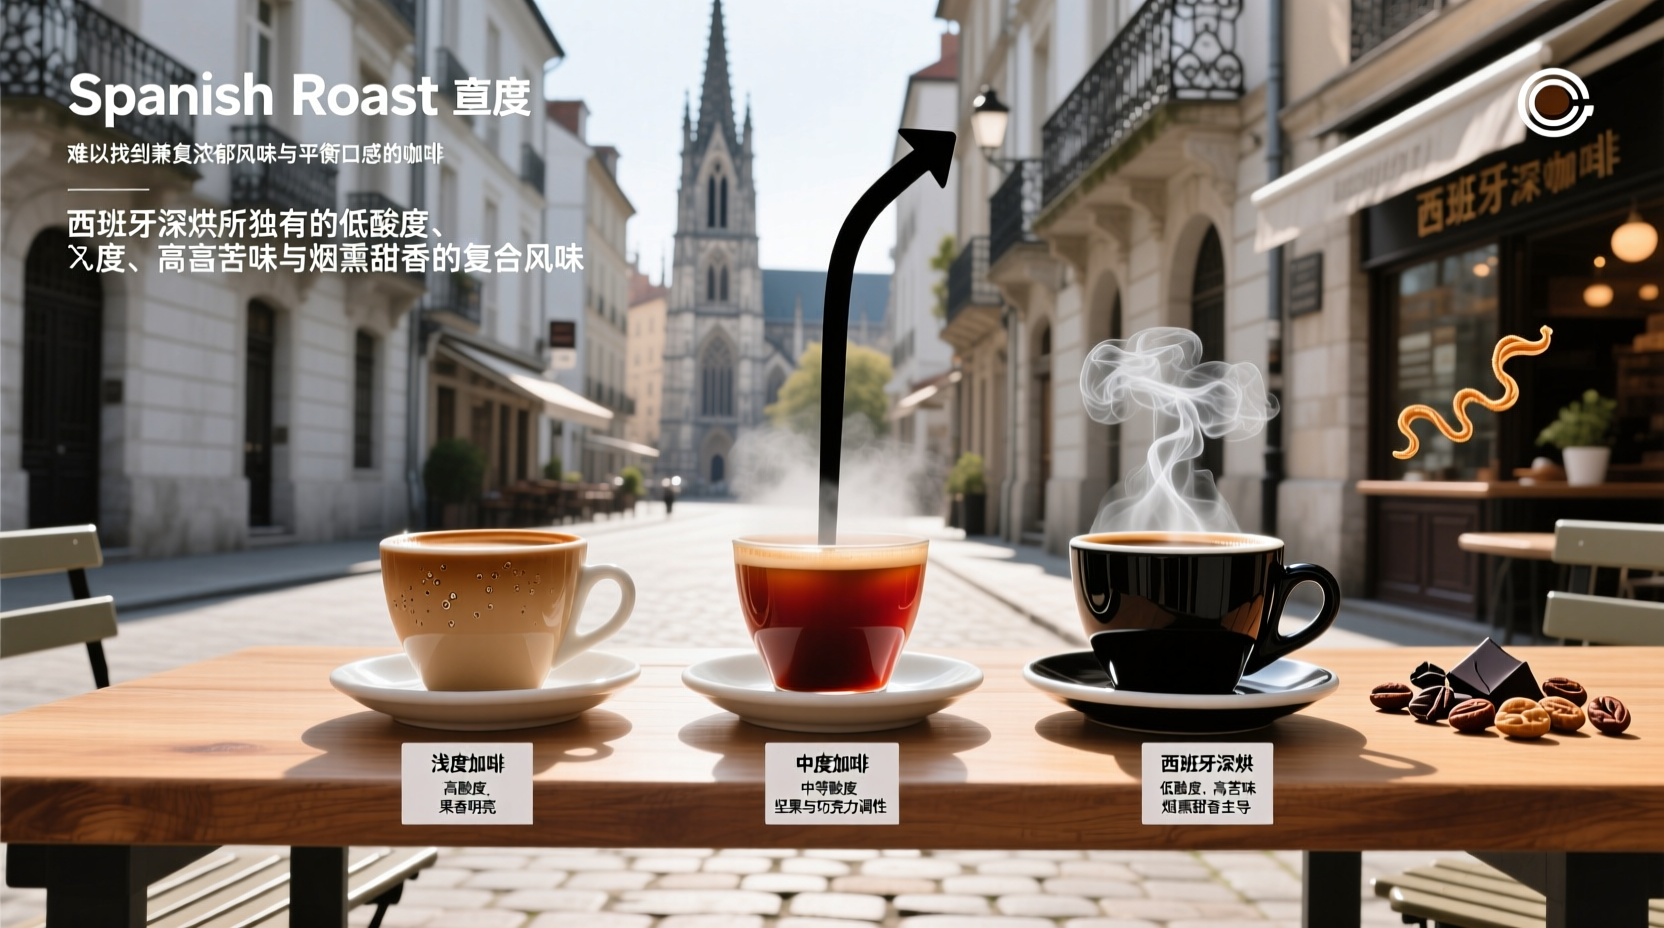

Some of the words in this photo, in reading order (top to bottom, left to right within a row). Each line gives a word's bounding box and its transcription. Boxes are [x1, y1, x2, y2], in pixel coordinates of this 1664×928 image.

[1416, 129, 1621, 238] 西班牙深咖啡
